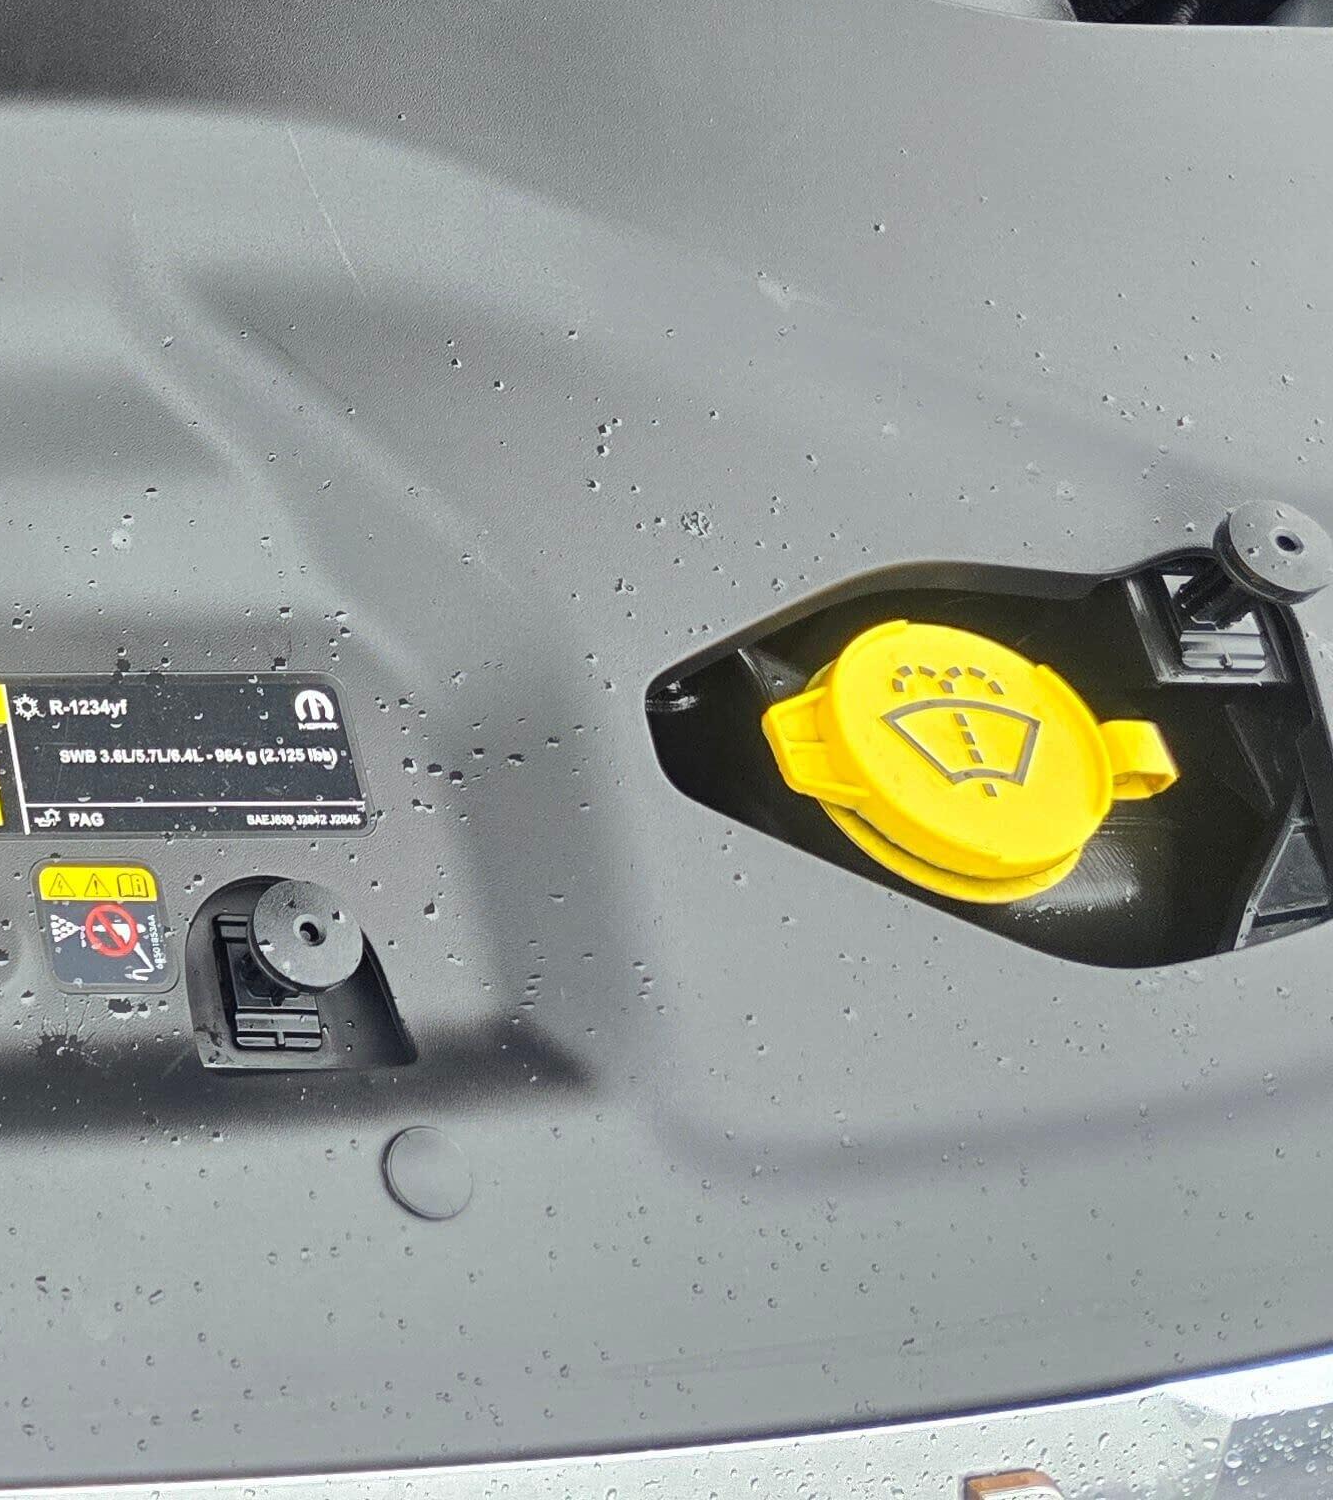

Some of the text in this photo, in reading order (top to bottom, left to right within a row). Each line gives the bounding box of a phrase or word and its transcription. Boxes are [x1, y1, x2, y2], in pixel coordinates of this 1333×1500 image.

[49, 698, 128, 719] R-1234yf
[59, 749, 97, 763] SWB
[245, 752, 257, 766] g
[259, 748, 306, 766] (2.125
[68, 812, 105, 827] PAG
